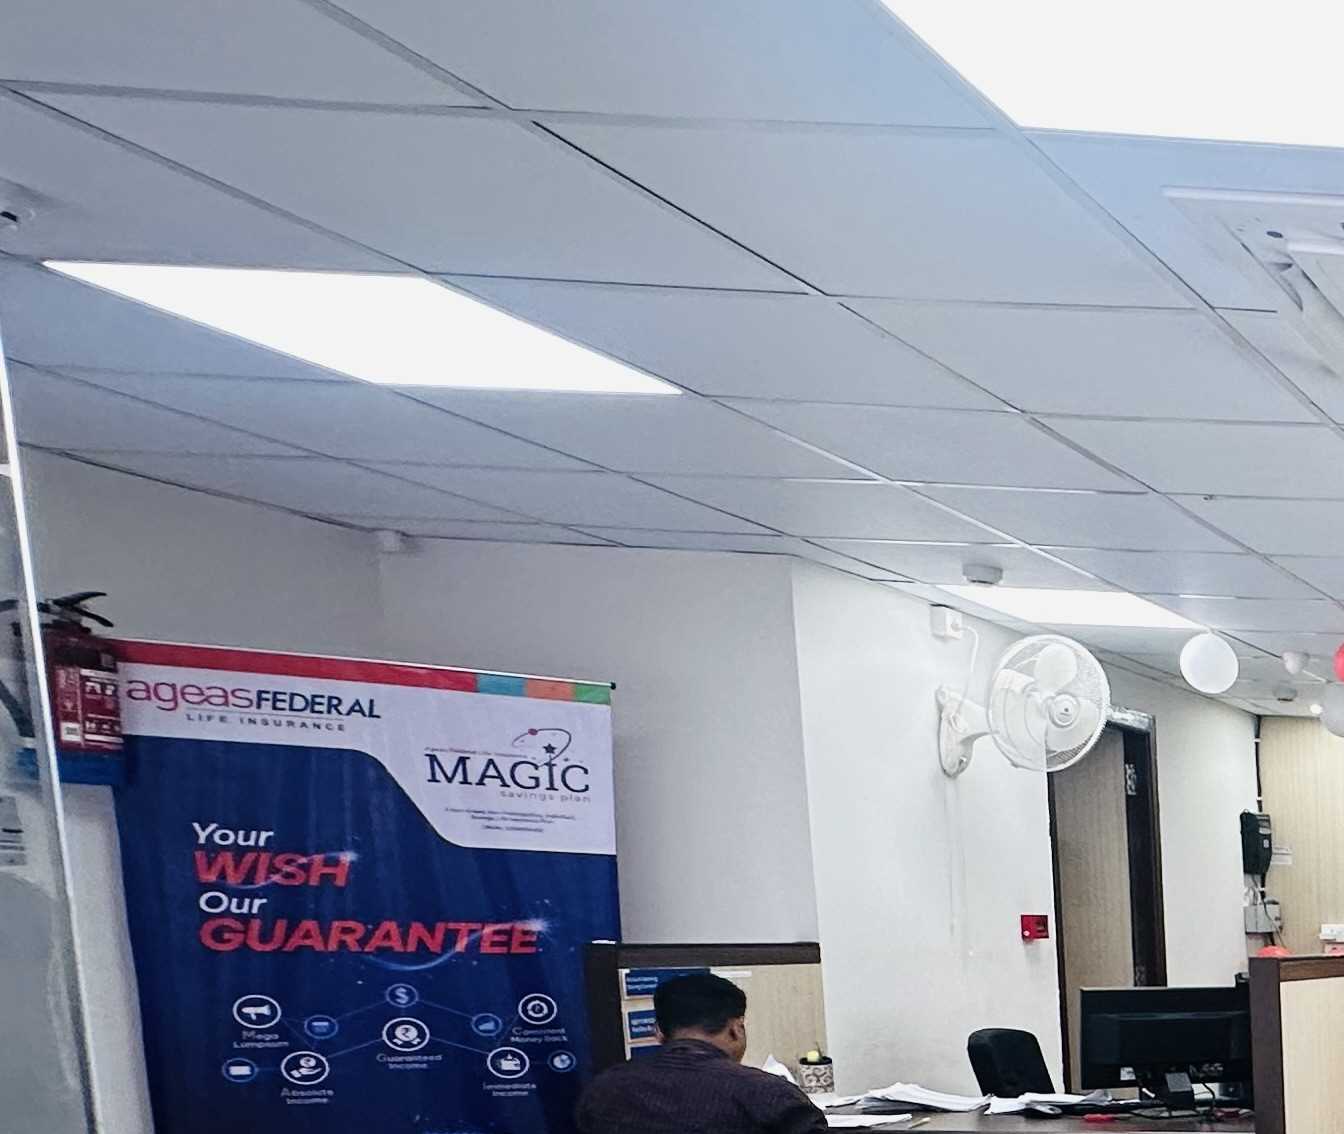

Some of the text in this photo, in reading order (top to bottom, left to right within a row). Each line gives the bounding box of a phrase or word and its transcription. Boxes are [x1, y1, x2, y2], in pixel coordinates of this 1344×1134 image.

[186, 713, 346, 732] LIFE INSURANCE
[424, 752, 590, 793] MAGIC
[500, 790, 592, 803] savings plan
[192, 822, 274, 847] Your
[193, 850, 352, 887] WISH
[199, 891, 268, 914] Our
[199, 917, 539, 954] GUARANTEE
[376, 1053, 444, 1063] Guaranteed
